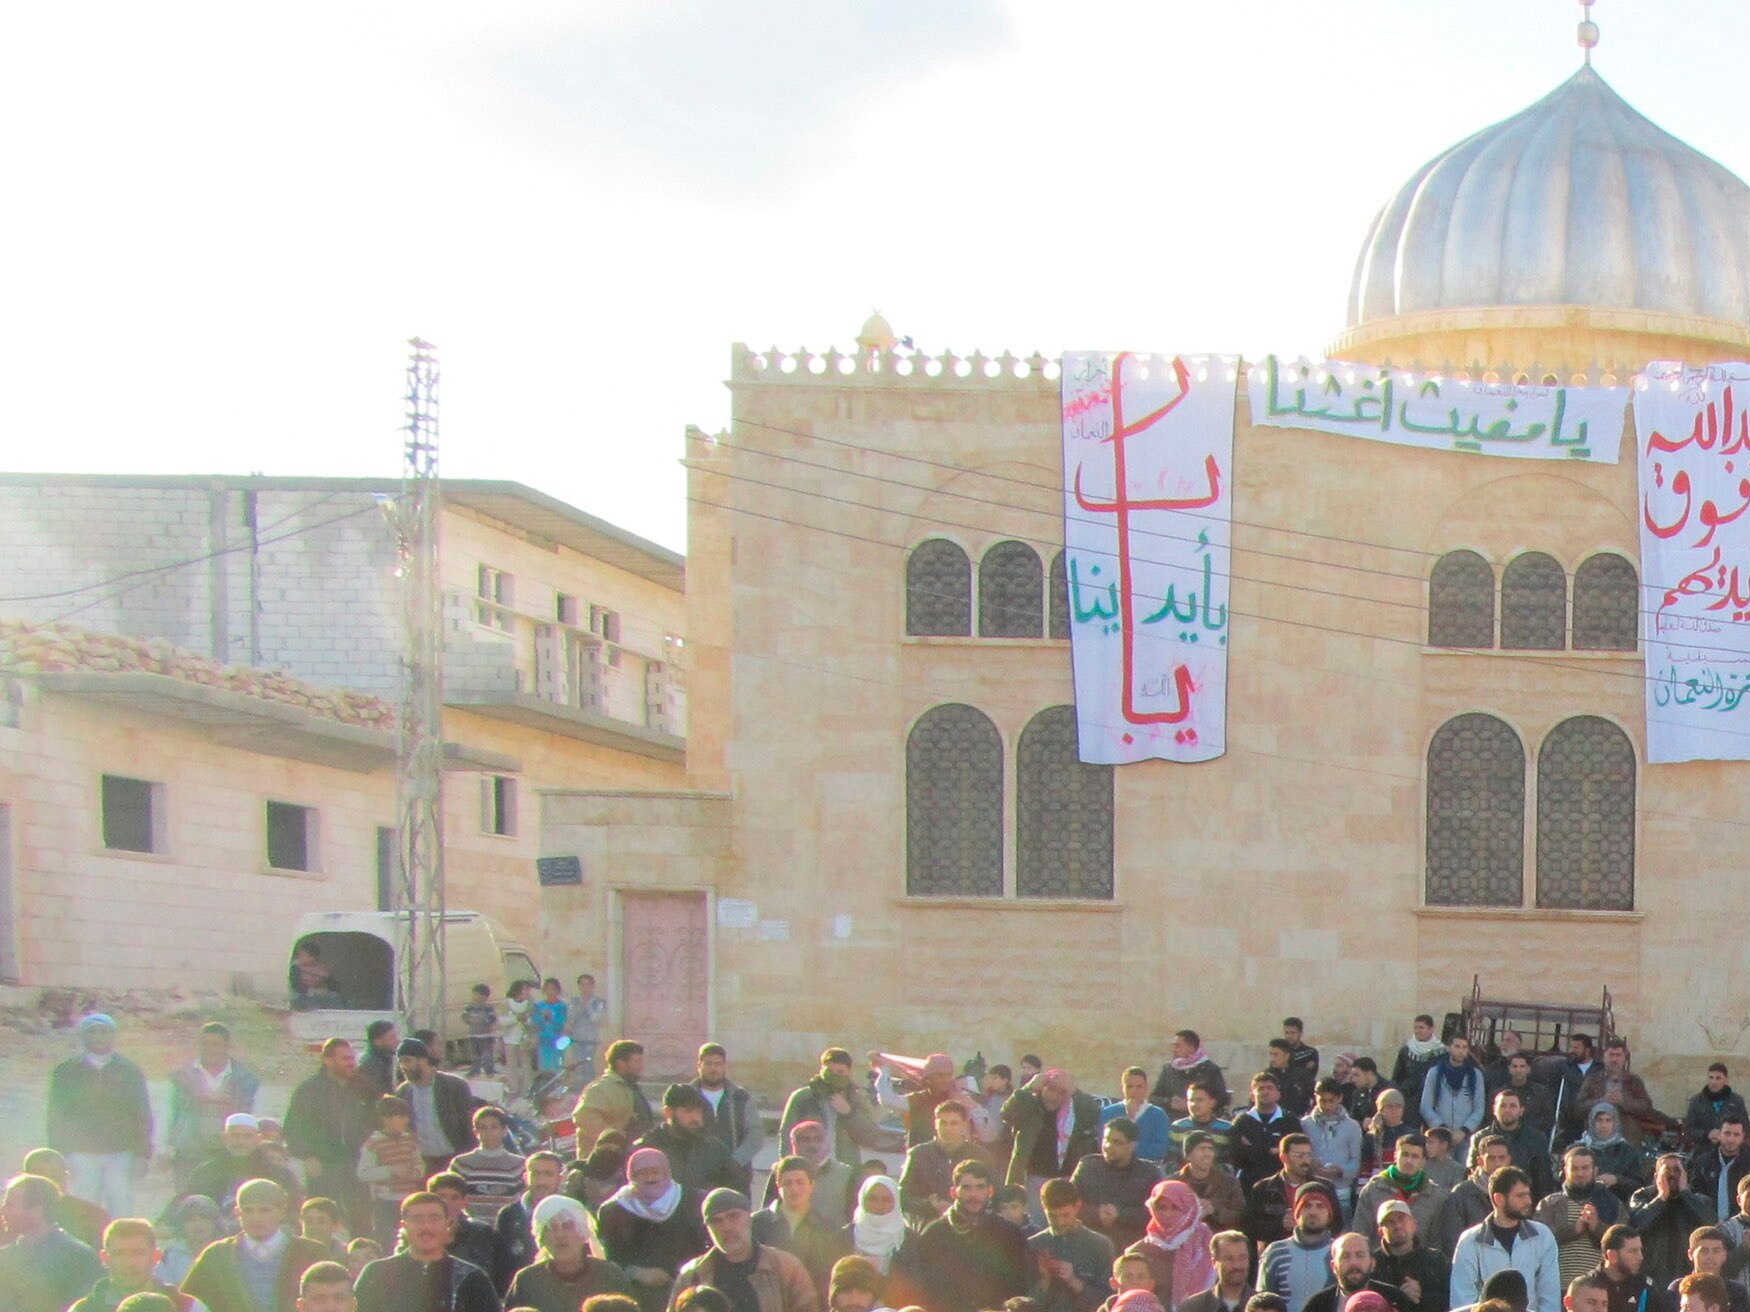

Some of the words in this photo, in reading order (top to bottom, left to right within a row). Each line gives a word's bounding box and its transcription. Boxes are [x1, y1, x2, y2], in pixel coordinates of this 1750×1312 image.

[1400, 379, 1546, 450] مغيث
[1550, 388, 1591, 458] يا
[1645, 384, 1734, 459] الله
[1654, 664, 1724, 710] النعمان
